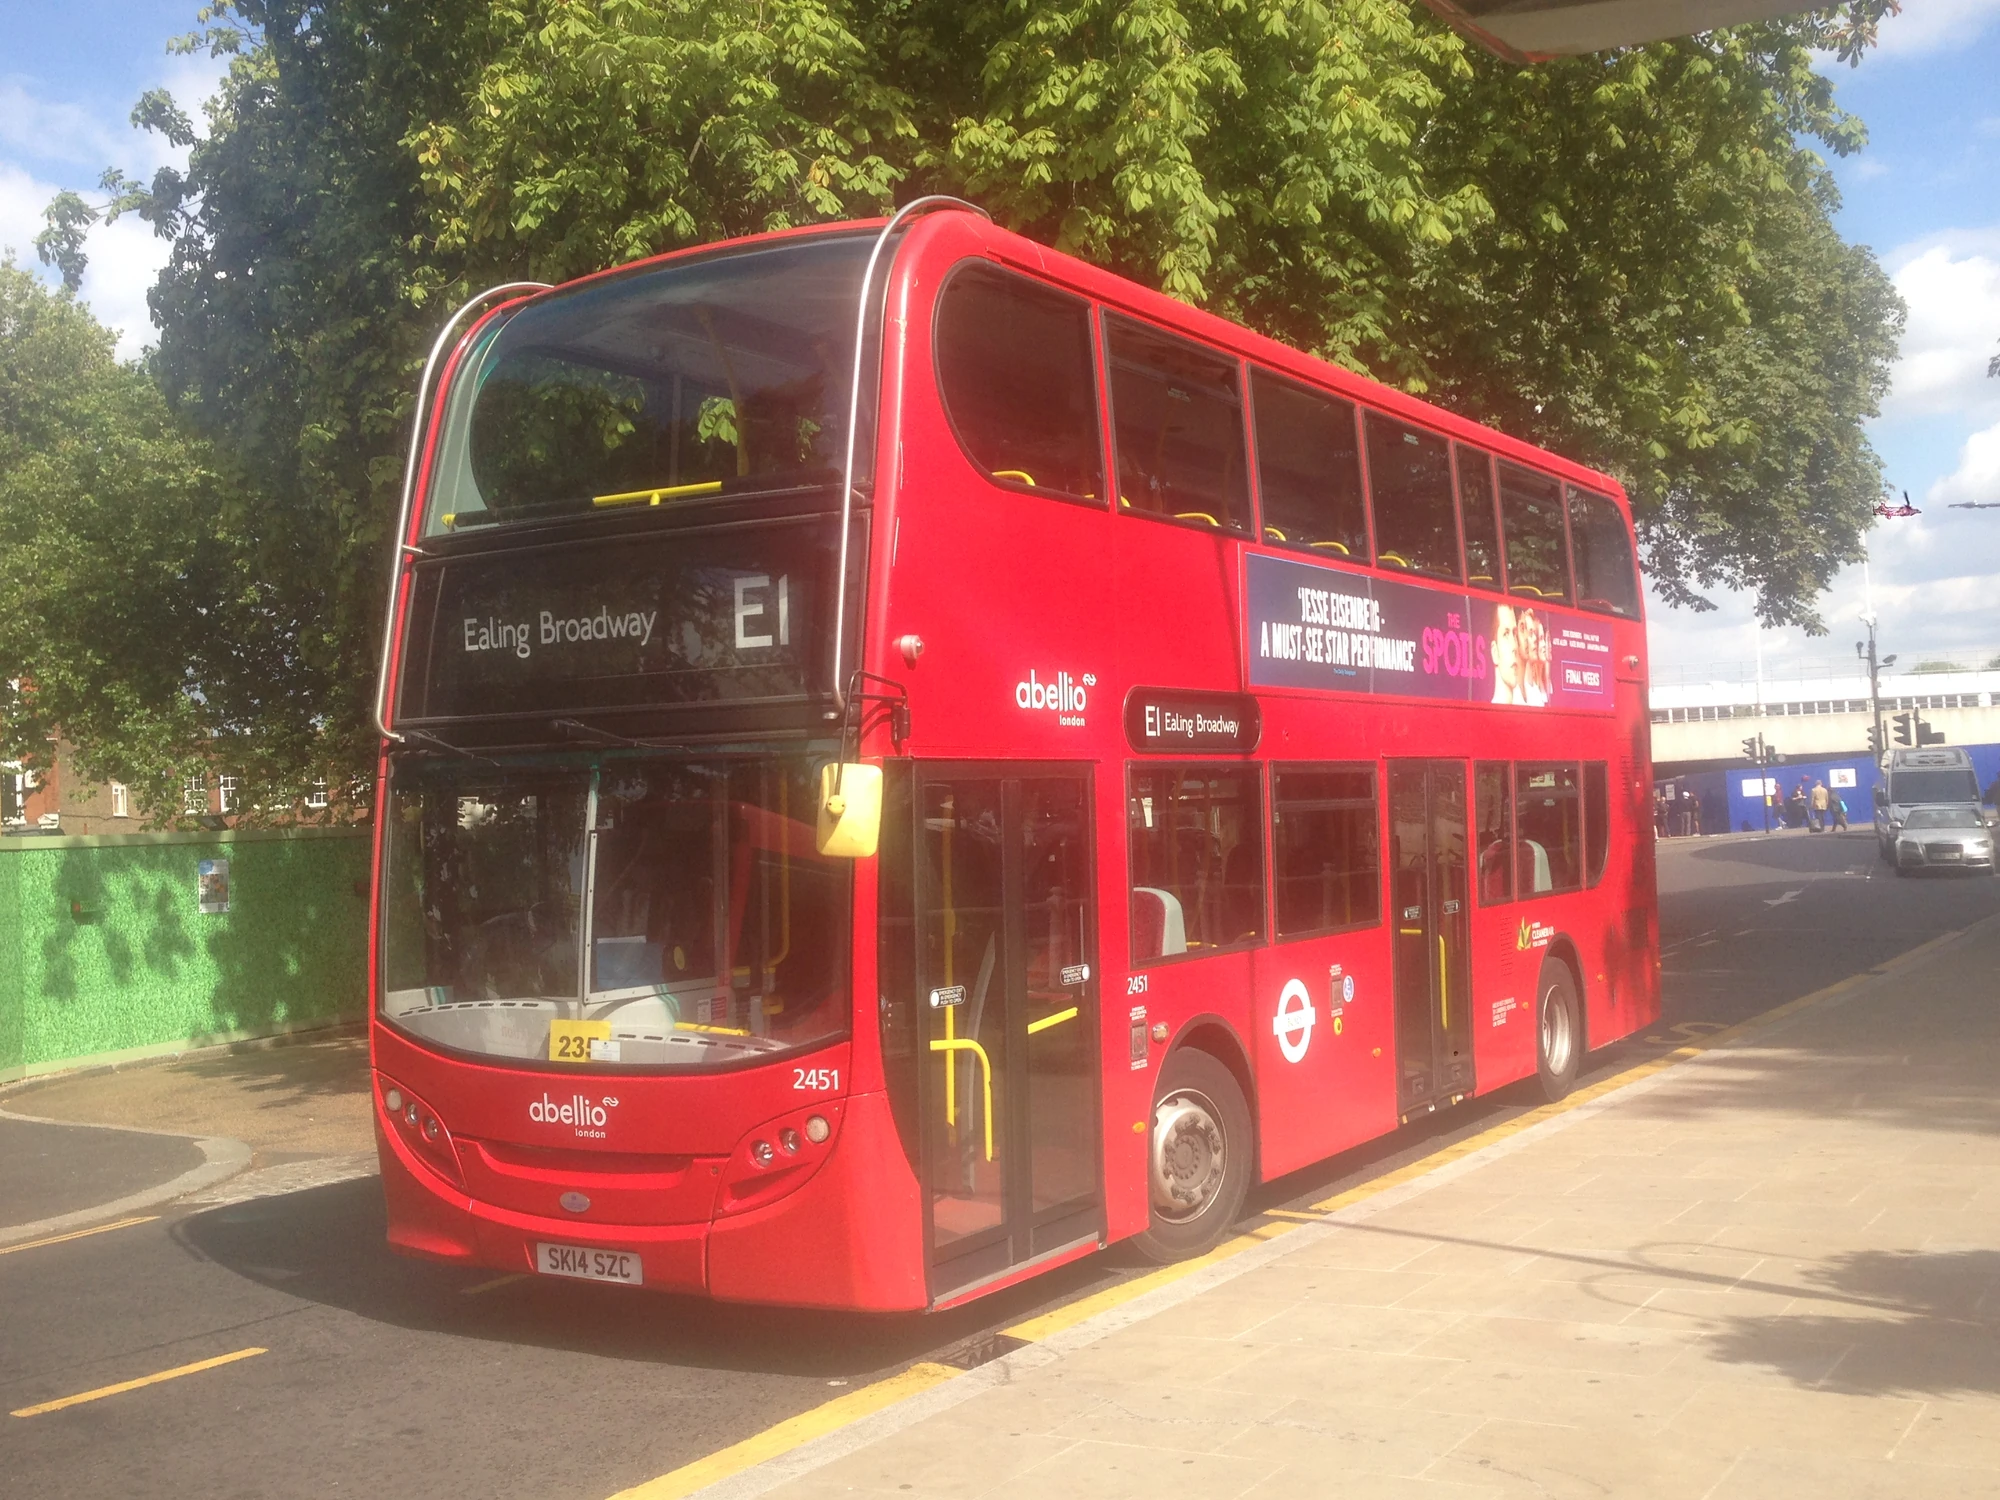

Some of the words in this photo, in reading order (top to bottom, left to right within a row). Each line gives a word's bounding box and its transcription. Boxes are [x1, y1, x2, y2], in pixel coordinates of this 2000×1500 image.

[733, 573, 790, 649] E1
[1331, 592, 1380, 632] EISENBERG
[1447, 612, 1460, 629] THE
[464, 617, 531, 659] Ealing
[540, 605, 657, 647] Broadway
[1260, 621, 1270, 658] A
[1272, 622, 1324, 663] MUST-SEE
[1325, 629, 1350, 666] STAR
[1422, 626, 1486, 680] SPOILS
[1015, 669, 1087, 712] abellio
[1565, 668, 1583, 685] FINAL
[1583, 671, 1600, 687] WEEKS
[1059, 715, 1085, 727] london
[1145, 705, 1161, 737] E1
[1165, 712, 1194, 738] Ealing
[1196, 713, 1240, 738] Broadway
[1127, 975, 1148, 995] 2451
[792, 1068, 839, 1091] 2451
[529, 1093, 607, 1127] abellio
[575, 1128, 606, 1139] london
[548, 1247, 589, 1274] SK14
[594, 1253, 631, 1279] SZC
